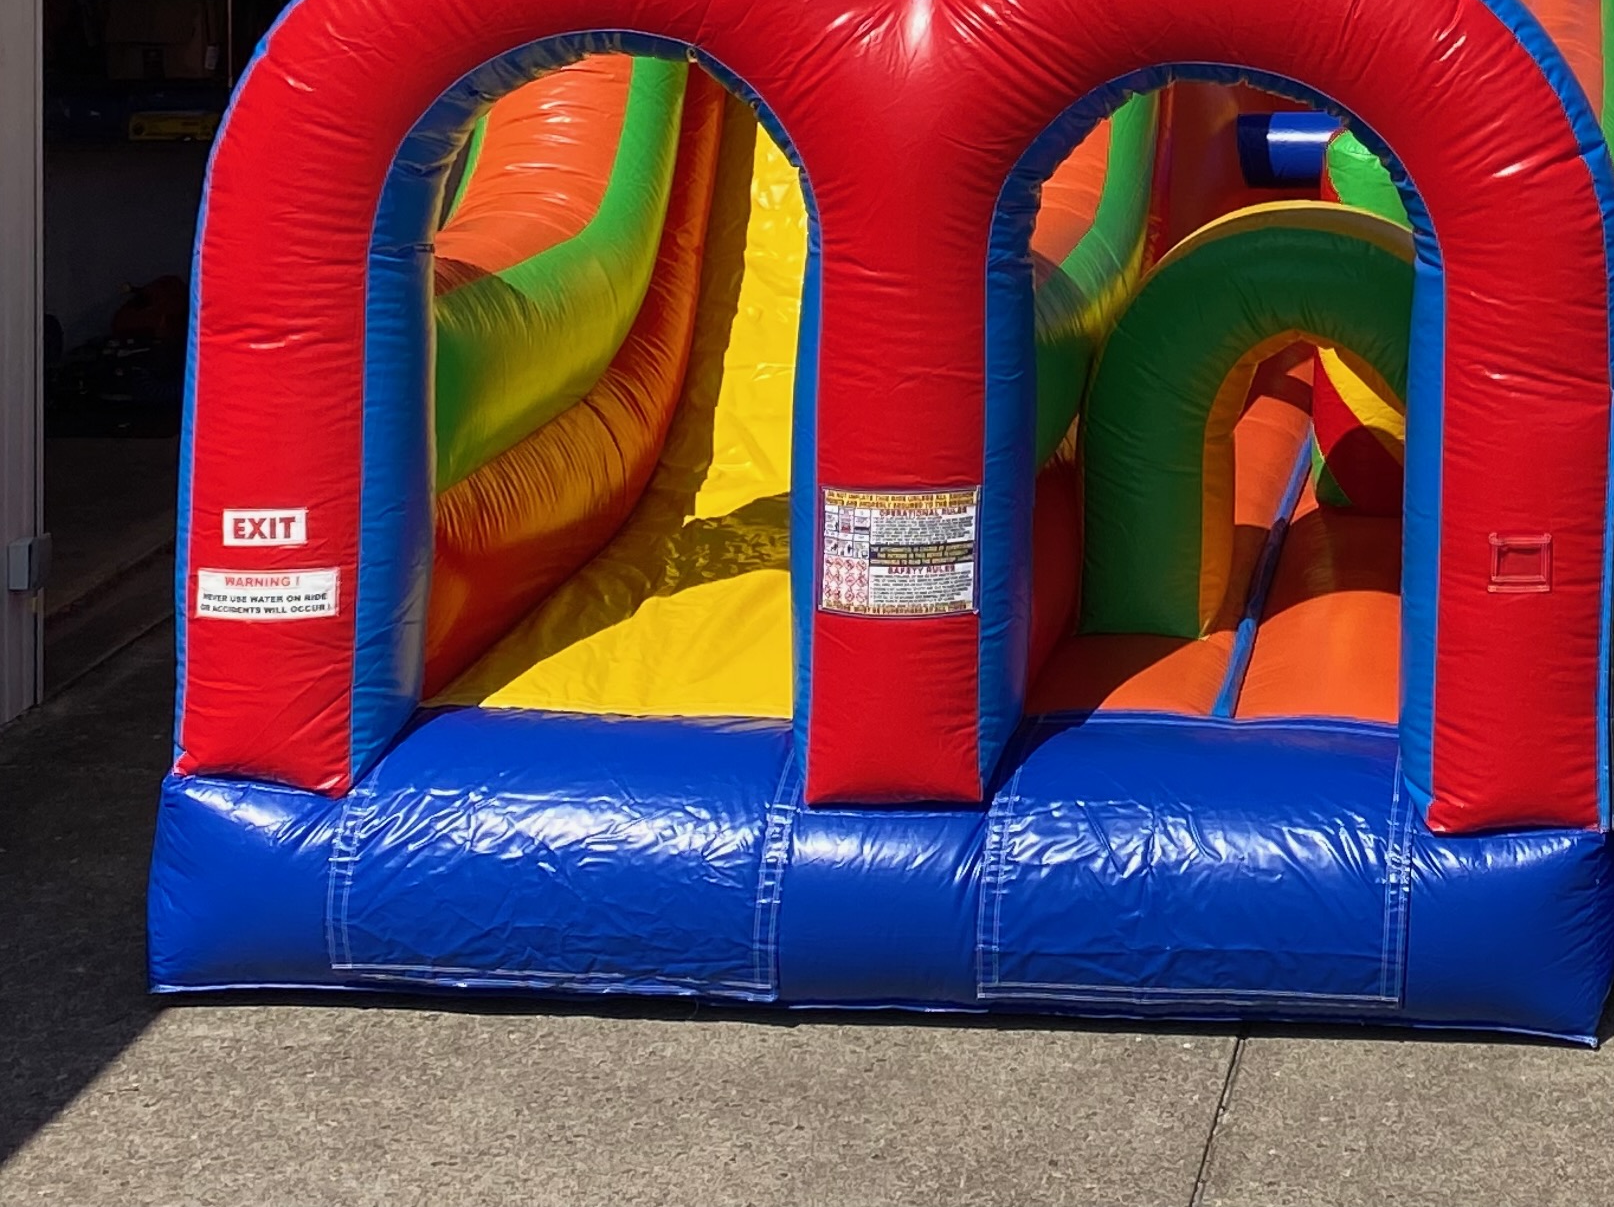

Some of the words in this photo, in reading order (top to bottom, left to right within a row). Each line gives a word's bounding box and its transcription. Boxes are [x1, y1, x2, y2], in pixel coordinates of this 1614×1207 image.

[233, 517, 296, 540] EXIT
[224, 576, 291, 587] WARNING
[203, 593, 227, 602] NEVER
[230, 595, 247, 603] USE
[250, 594, 284, 603] WATER
[286, 594, 301, 602] ON
[304, 592, 327, 601] RIDE
[200, 604, 210, 612] OR
[212, 605, 261, 614] ACCIDENTS
